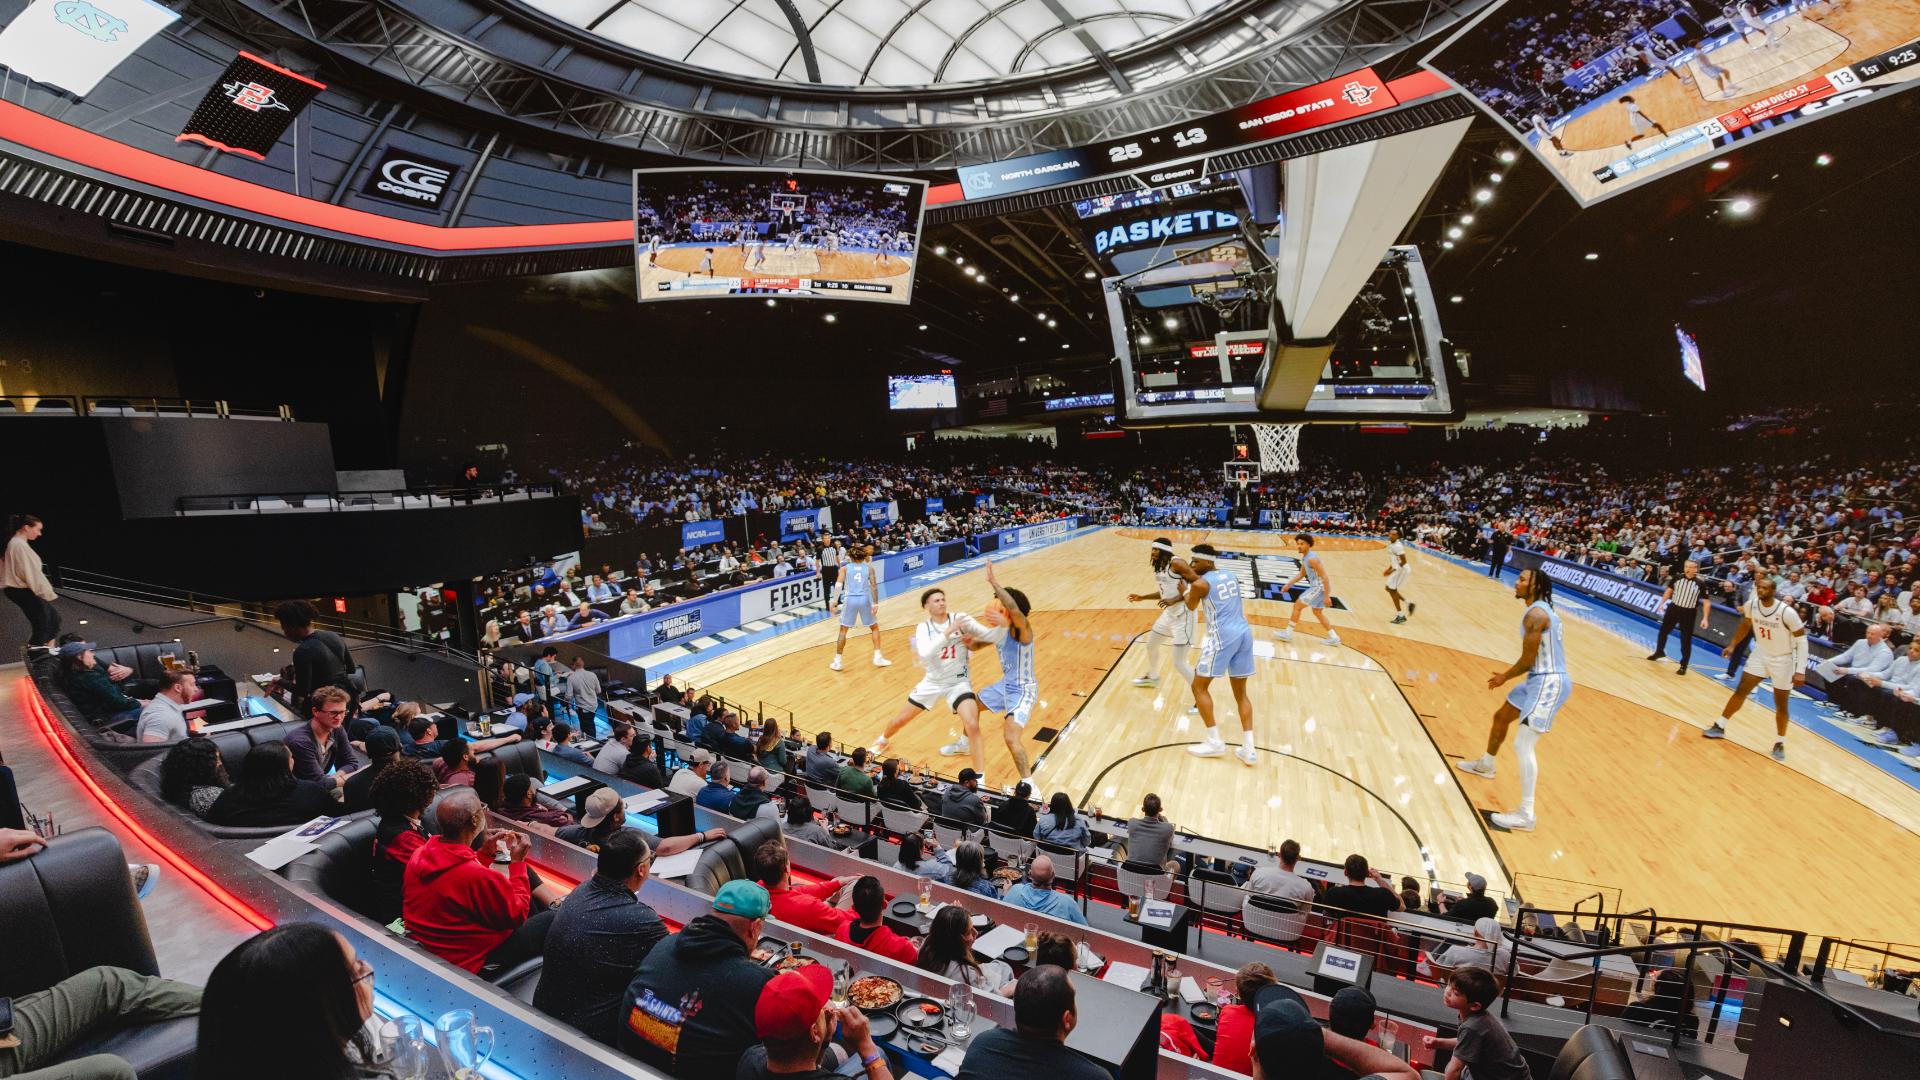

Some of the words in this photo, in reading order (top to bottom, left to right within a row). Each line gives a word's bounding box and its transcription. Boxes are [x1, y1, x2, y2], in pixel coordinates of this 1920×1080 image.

[1888, 49, 1917, 66] 9:25
[1833, 71, 1854, 87] 13
[1860, 65, 1880, 77] 1ST
[1751, 100, 1771, 112] SAN
[1770, 88, 1798, 106] DIEGO
[1797, 84, 1809, 95] ST
[1239, 117, 1264, 130] SAN
[1263, 109, 1296, 124] DIEGO
[1295, 98, 1335, 115] STATE
[1703, 122, 1722, 136] 25
[1109, 143, 1143, 163] 25
[1173, 128, 1207, 148] 13
[1001, 168, 1034, 182] NORTH
[1034, 160, 1080, 175] CAROLINA
[790, 517, 807, 525] MARCH
[853, 572, 862, 583] 4
[1540, 560, 1587, 586] CELEBRATES
[770, 578, 822, 611] FIRST
[1217, 580, 1239, 600] 22
[662, 614, 689, 631] MARCH
[667, 620, 702, 640] MADNESS
[1759, 627, 1772, 640] 31
[941, 644, 957, 660] 21
